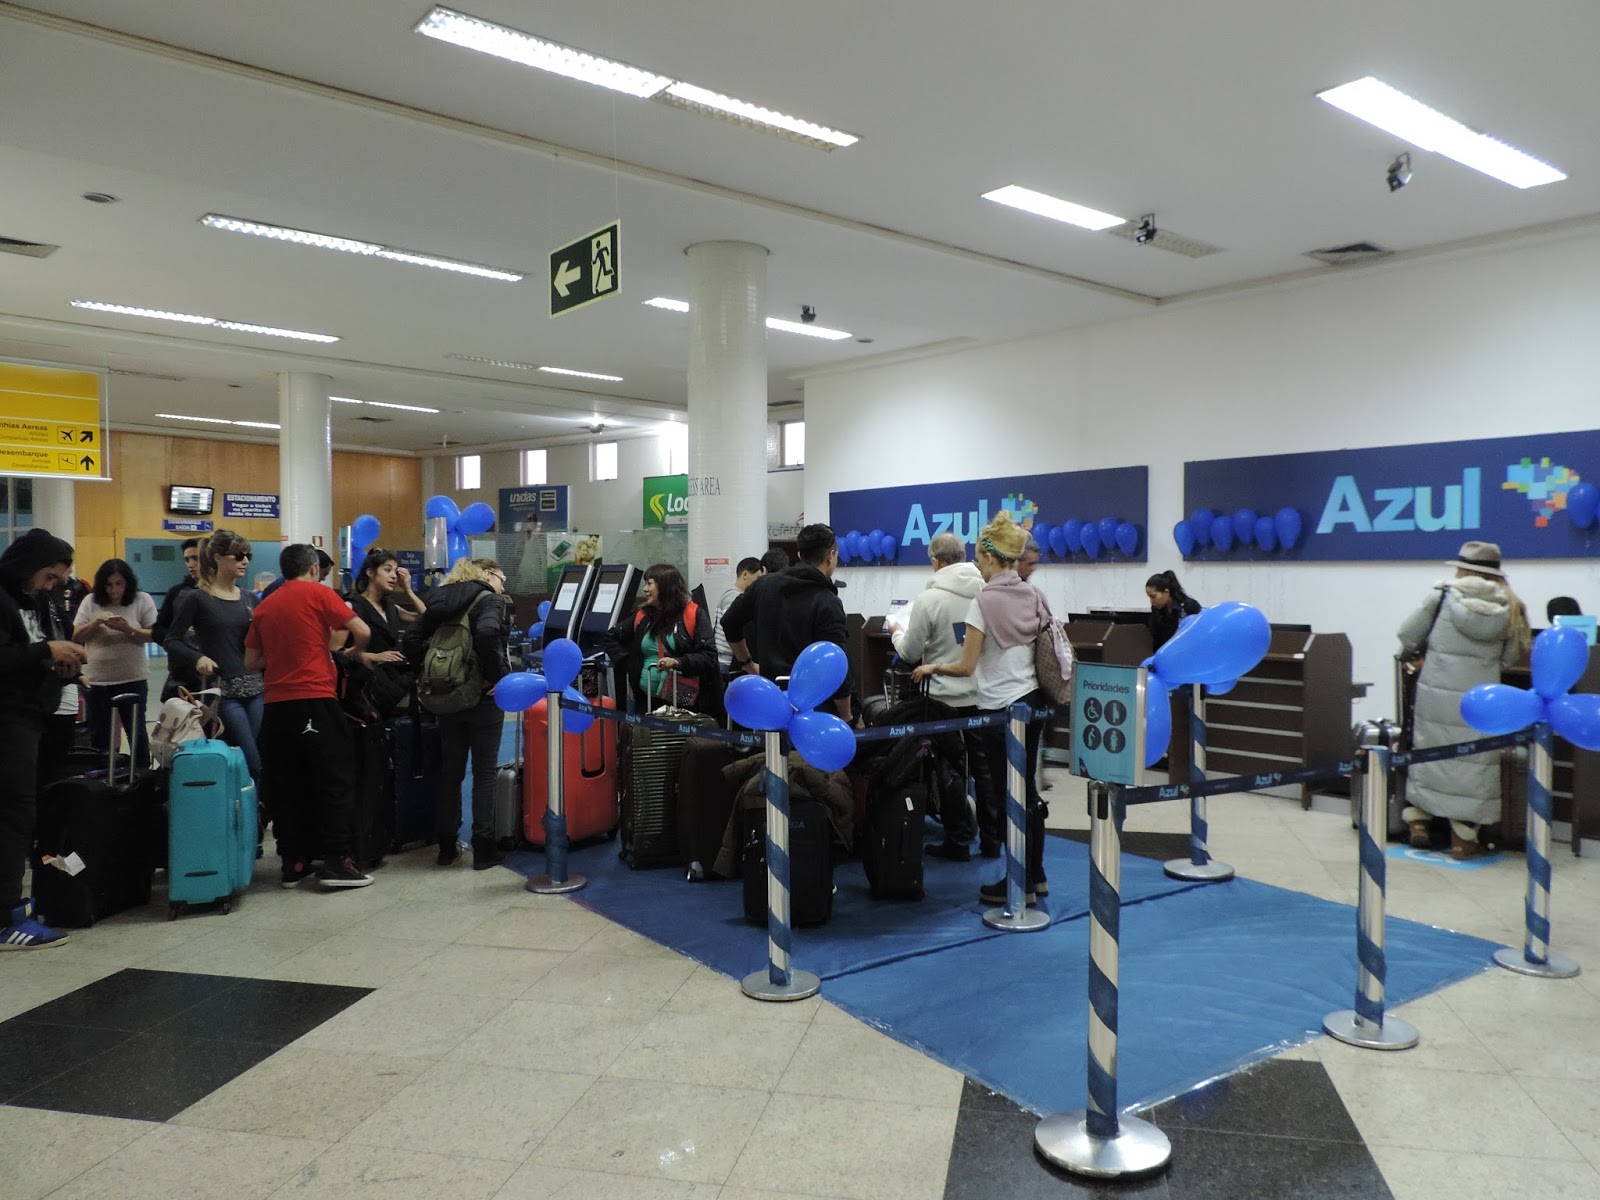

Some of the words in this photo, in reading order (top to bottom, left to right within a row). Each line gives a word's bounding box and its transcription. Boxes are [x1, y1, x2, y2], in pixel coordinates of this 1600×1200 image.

[700, 476, 721, 496] AREA
[226, 494, 277, 503] ESTACIONAMENTO
[509, 491, 537, 503] unidas
[1316, 467, 1481, 534] Azul
[902, 499, 988, 546] Azul
[1083, 680, 1130, 694] Prioridades
[967, 717, 983, 728] Azul
[679, 724, 690, 734] Azul
[889, 726, 906, 737] Azul
[740, 733, 754, 743] Azul
[1254, 773, 1273, 786] Azul
[1159, 785, 1179, 798] Azul
